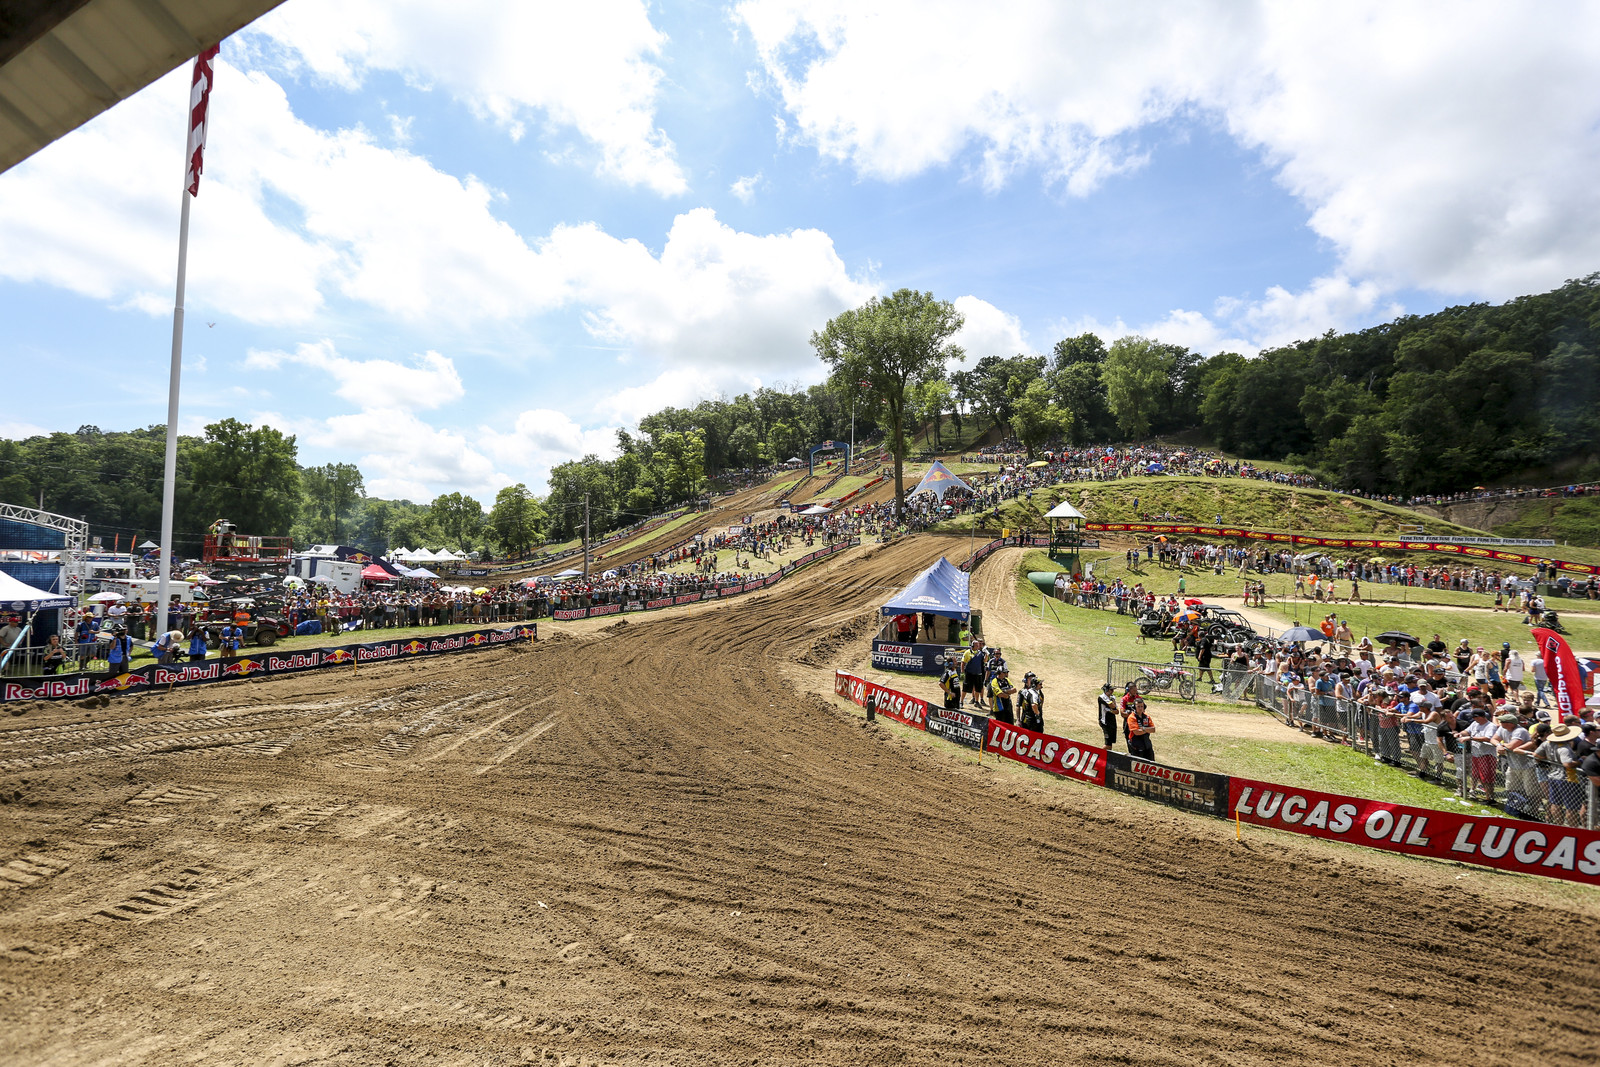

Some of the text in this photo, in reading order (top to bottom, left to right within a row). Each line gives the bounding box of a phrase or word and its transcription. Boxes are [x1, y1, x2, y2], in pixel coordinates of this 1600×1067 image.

[880, 644, 900, 653] LUCAS
[904, 700, 924, 724] OIL
[940, 710, 960, 721] LUCAS
[989, 726, 1099, 778] LUCAS OIL
[1134, 763, 1191, 784] LUCAS OIL
[1114, 774, 1215, 806] MOTOCROSS
[1234, 786, 1430, 847] LUCAS OIL
[1451, 822, 1600, 876] LUCAS
